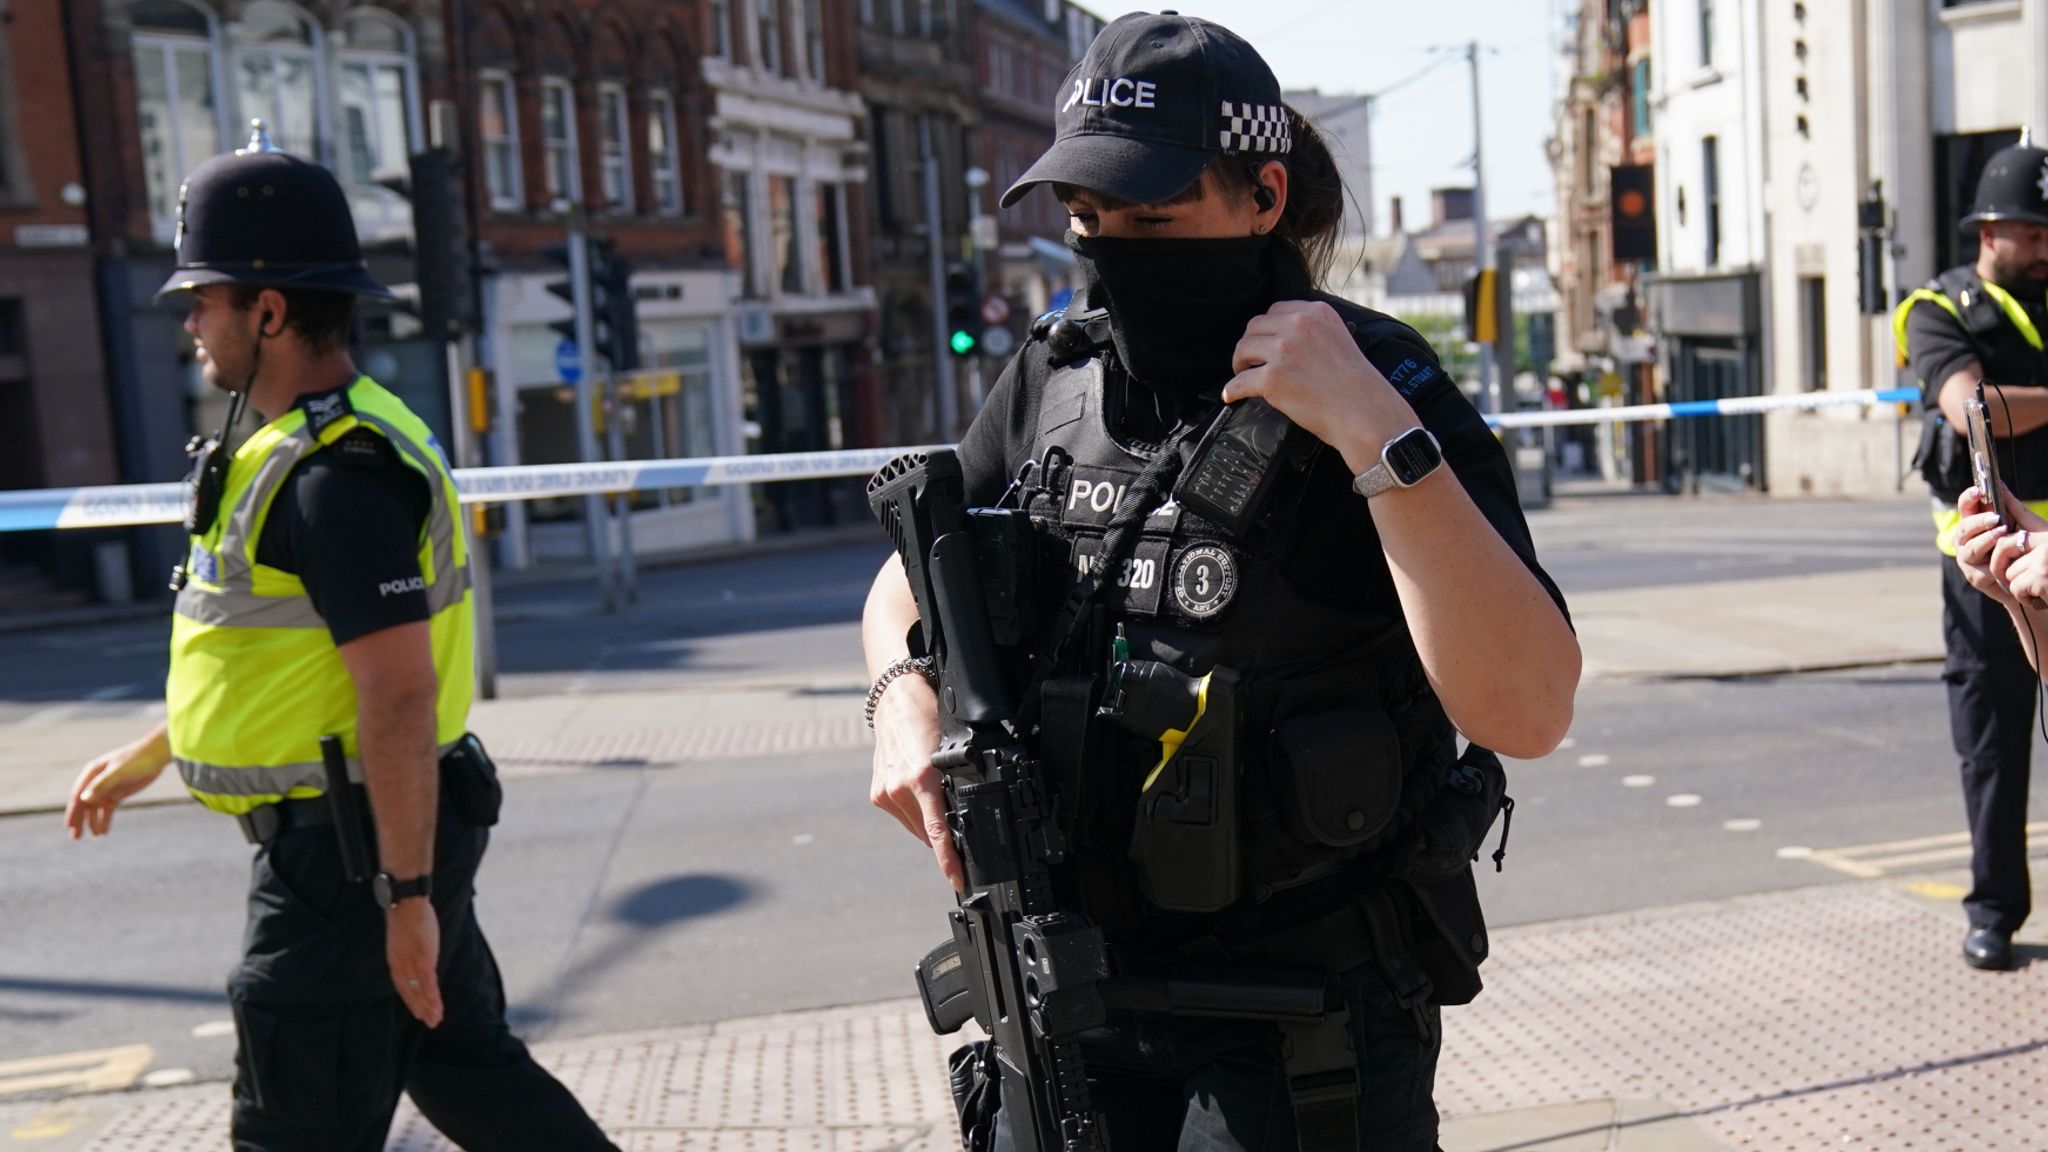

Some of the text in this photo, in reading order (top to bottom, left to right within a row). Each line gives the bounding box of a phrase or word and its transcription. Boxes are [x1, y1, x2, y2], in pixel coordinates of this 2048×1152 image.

[1068, 479, 1177, 516] POL
[378, 576, 425, 597] POLIC
[1117, 558, 1155, 589] 320
[1195, 565, 1210, 595] 3
